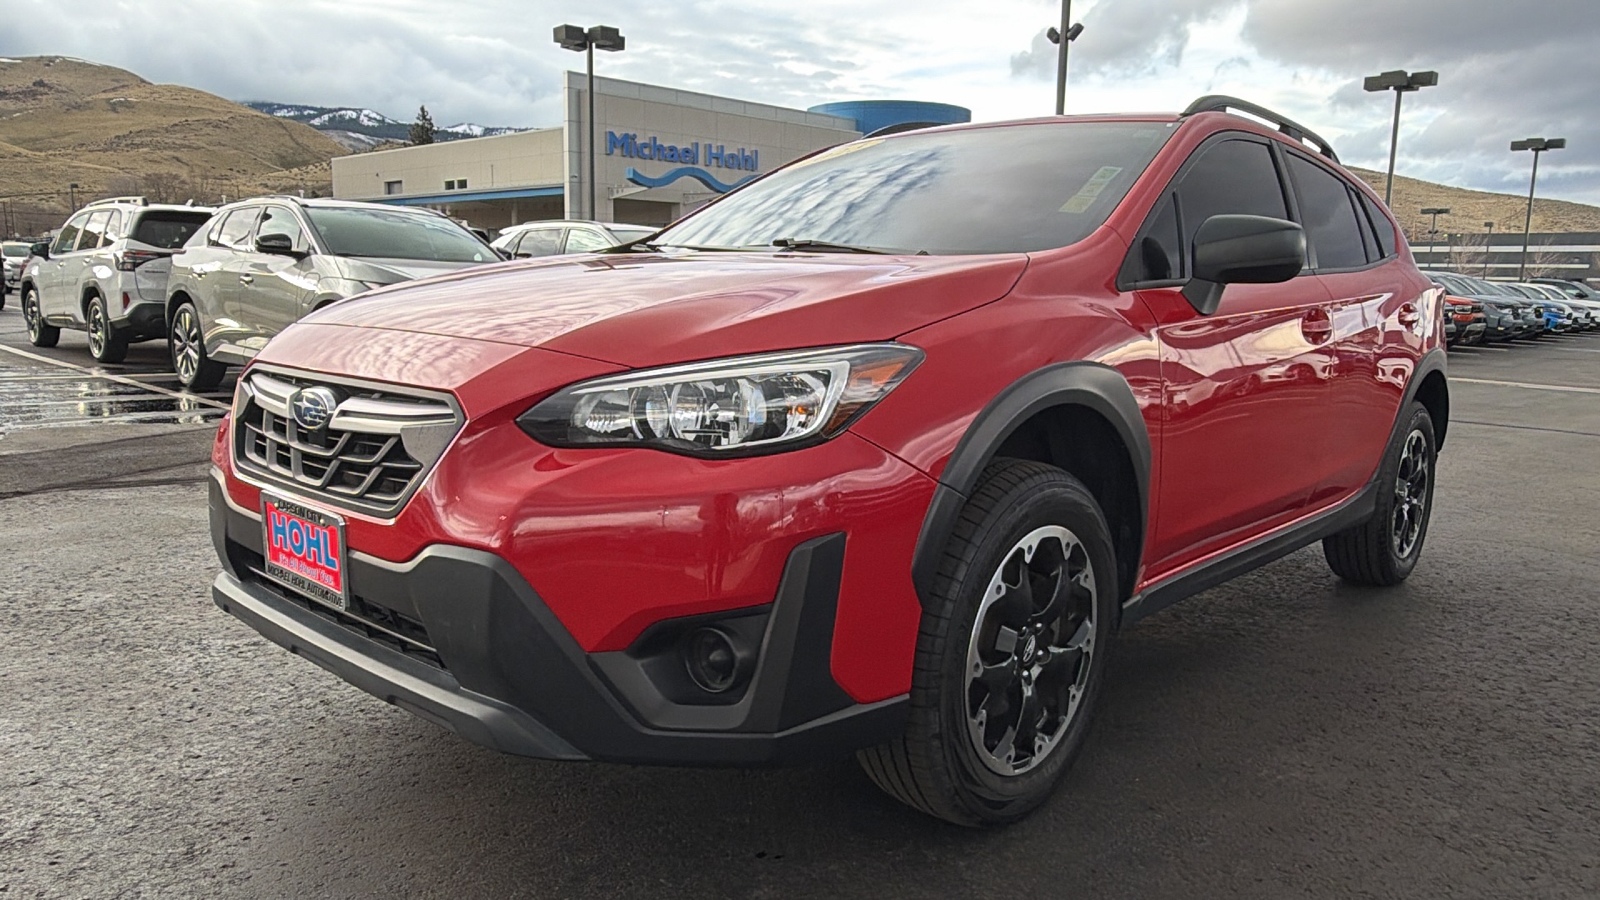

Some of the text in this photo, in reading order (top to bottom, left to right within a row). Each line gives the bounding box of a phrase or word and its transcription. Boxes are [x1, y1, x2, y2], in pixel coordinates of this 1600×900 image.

[606, 131, 758, 171] Michael Hohl
[307, 510, 321, 523] CITY
[271, 511, 338, 570] HOHL
[306, 582, 343, 607] AUTOMOTIVE
